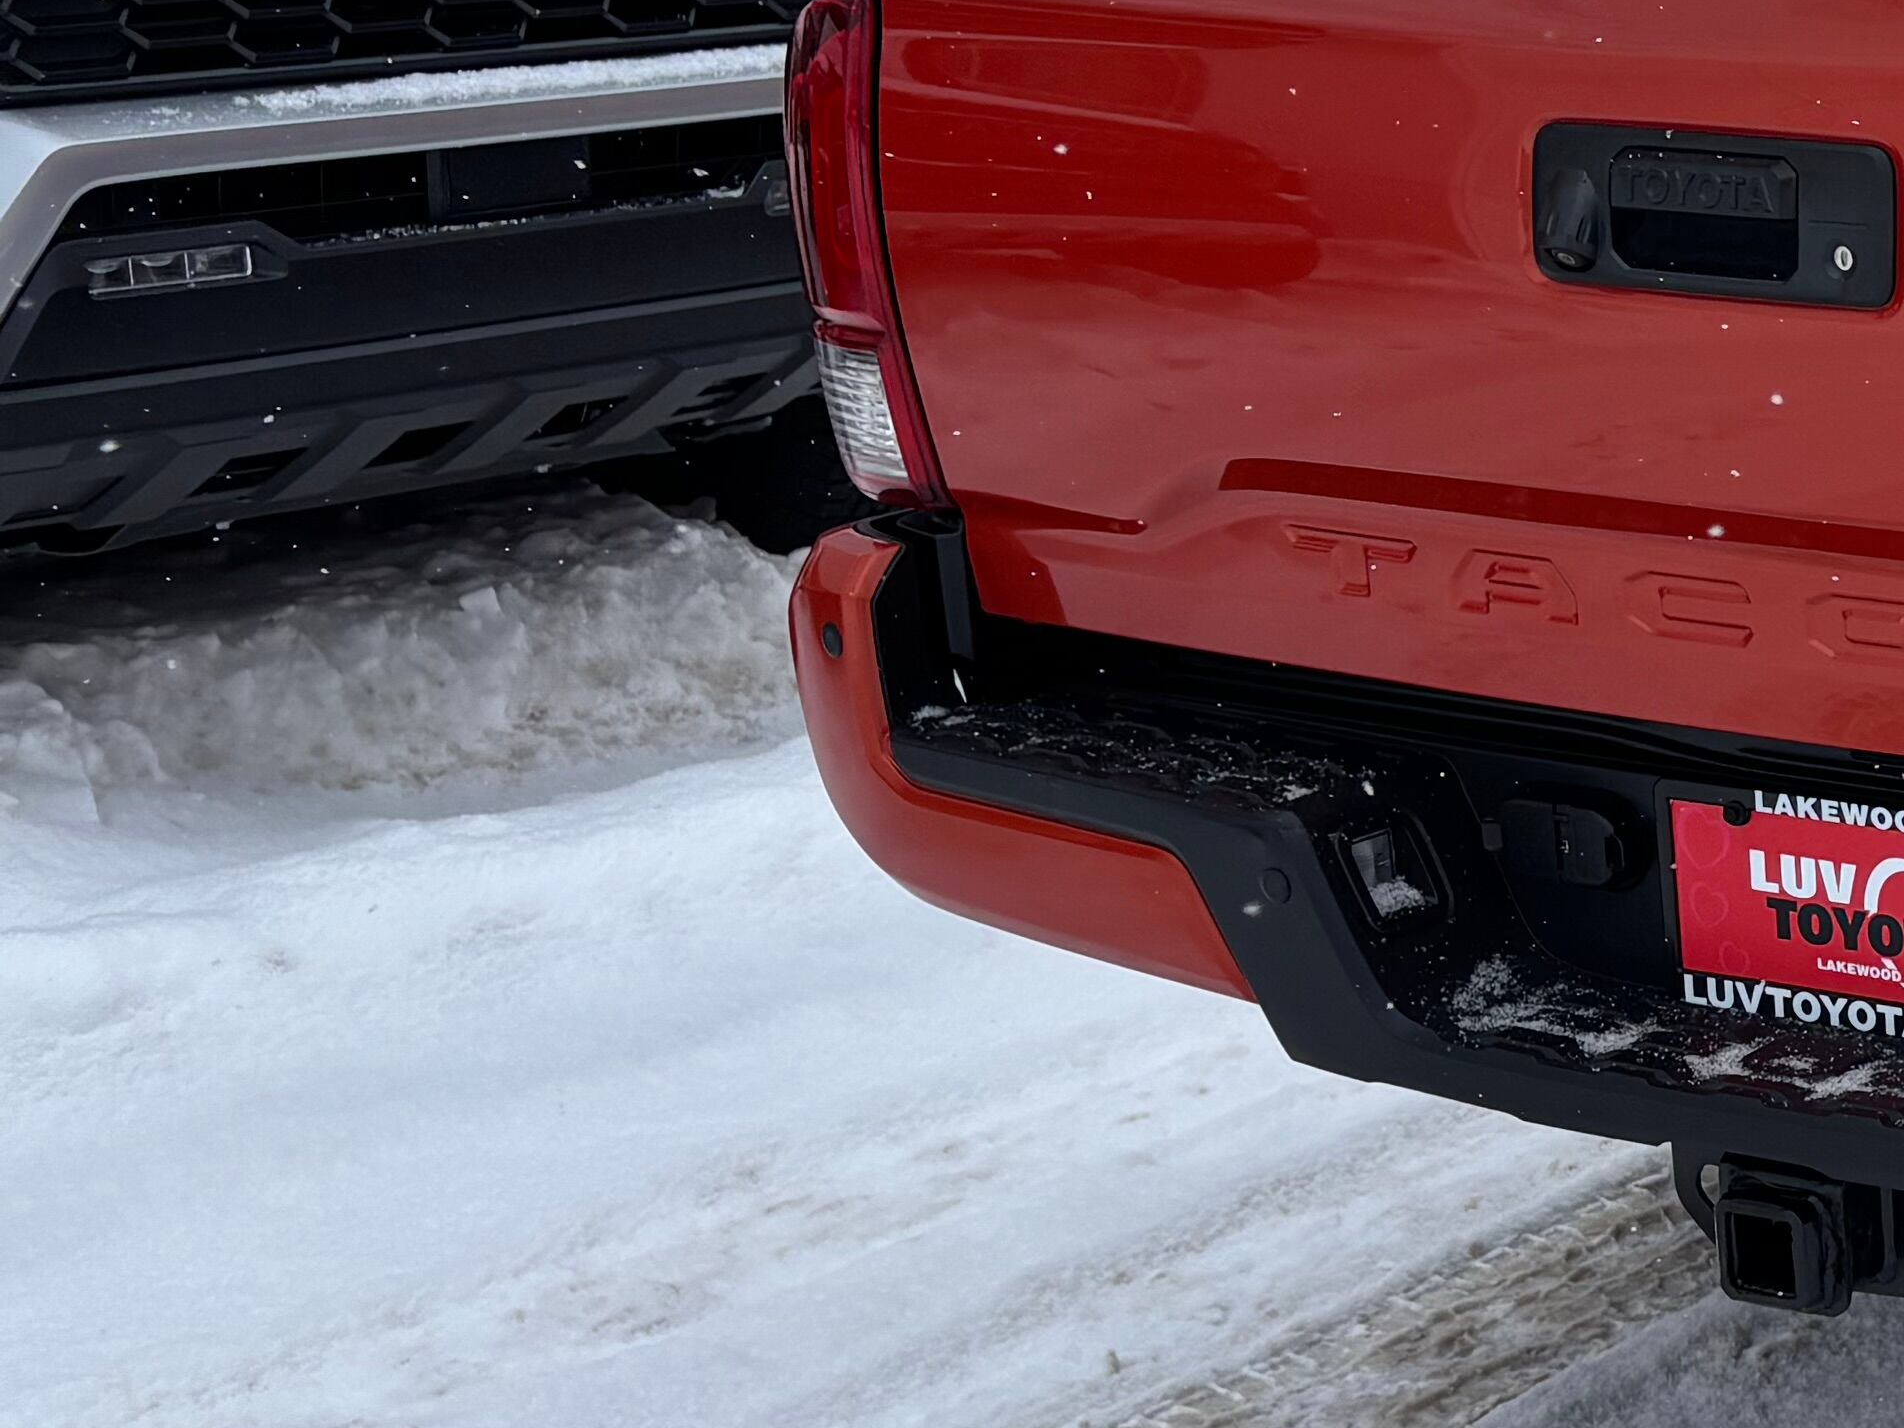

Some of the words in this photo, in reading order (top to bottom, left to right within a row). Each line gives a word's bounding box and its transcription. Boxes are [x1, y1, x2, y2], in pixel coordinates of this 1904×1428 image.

[1620, 164, 1777, 214] TOYOTA
[1749, 849, 1856, 905] LUV
[1816, 957, 1903, 984] LAKEWOOD
